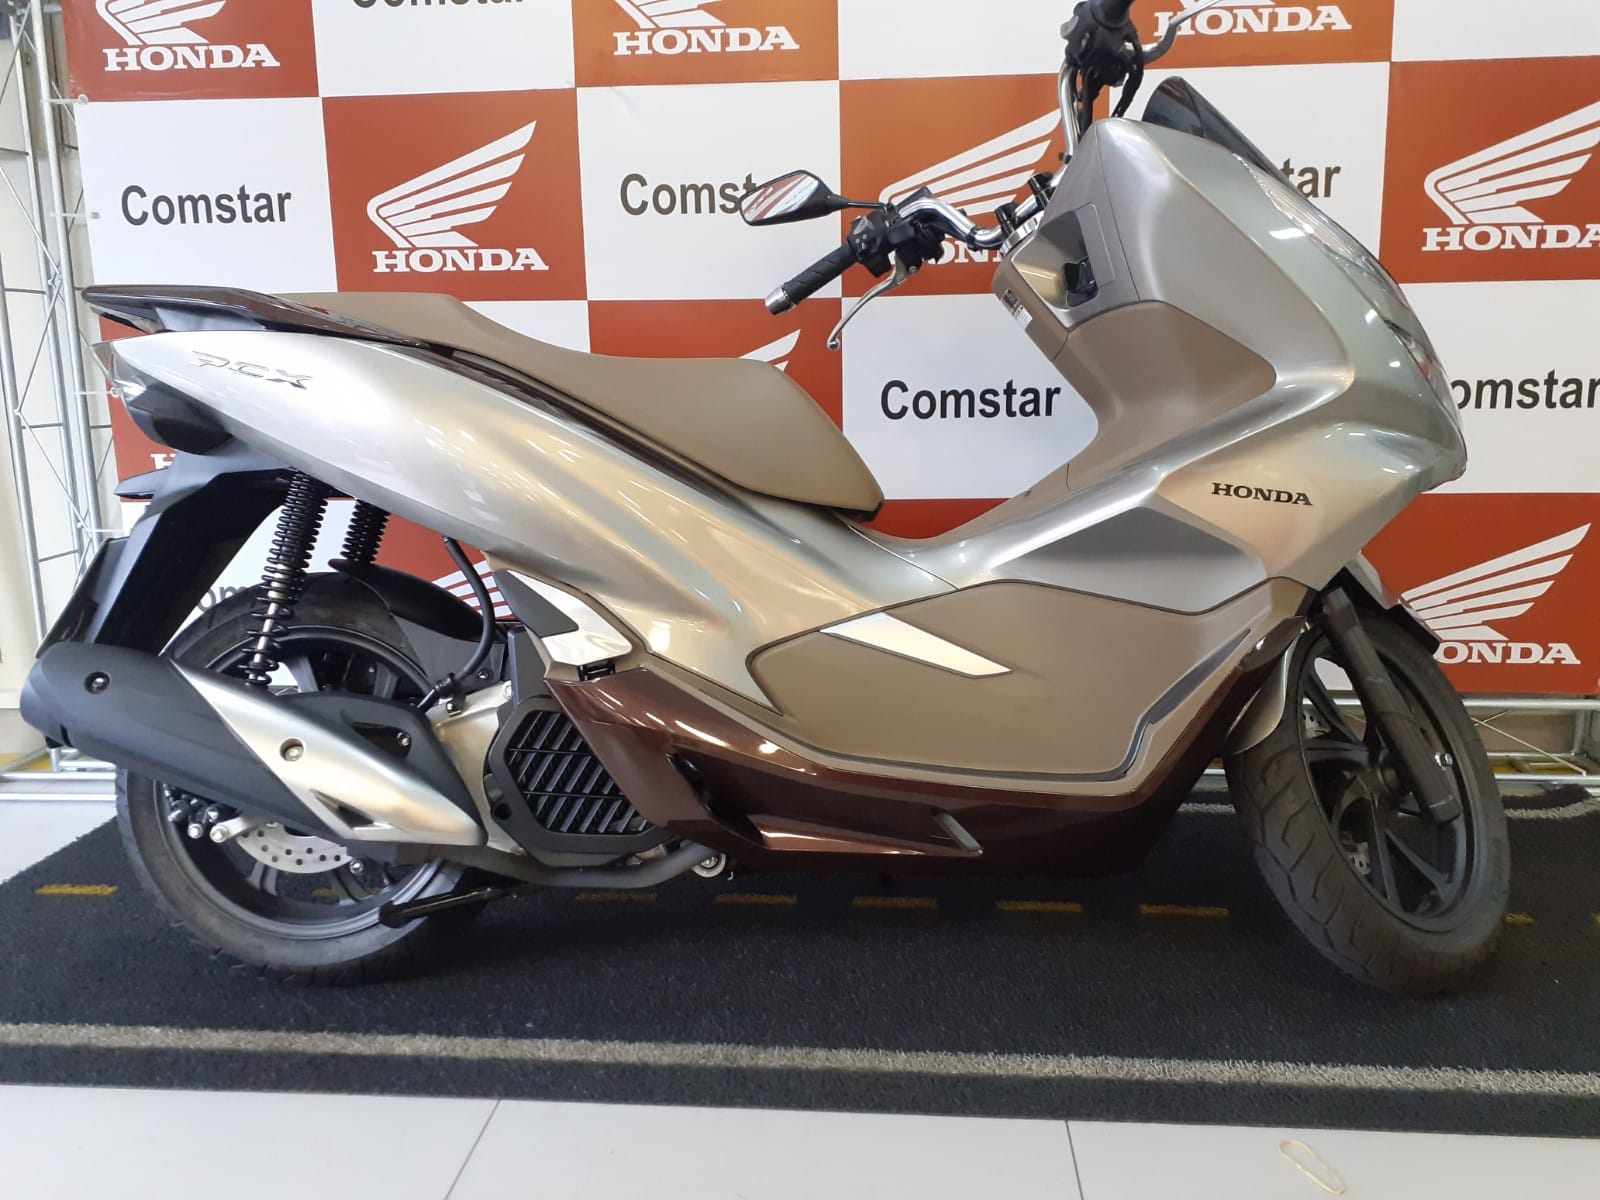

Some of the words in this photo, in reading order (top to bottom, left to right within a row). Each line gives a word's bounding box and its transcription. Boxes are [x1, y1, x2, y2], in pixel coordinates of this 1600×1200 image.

[1153, 5, 1353, 36] HONDA
[612, 26, 800, 55] HONDA
[103, 43, 281, 72] HONDA
[121, 184, 292, 226] Comstar
[620, 173, 757, 216] Coms
[1421, 223, 1600, 252] HONDA
[371, 247, 550, 273] HONDA
[189, 350, 314, 391] PCX
[880, 379, 1062, 421] Comstar
[1450, 368, 1600, 410] omstar
[1210, 482, 1313, 507] HONDA
[1432, 641, 1582, 665] ONDA
